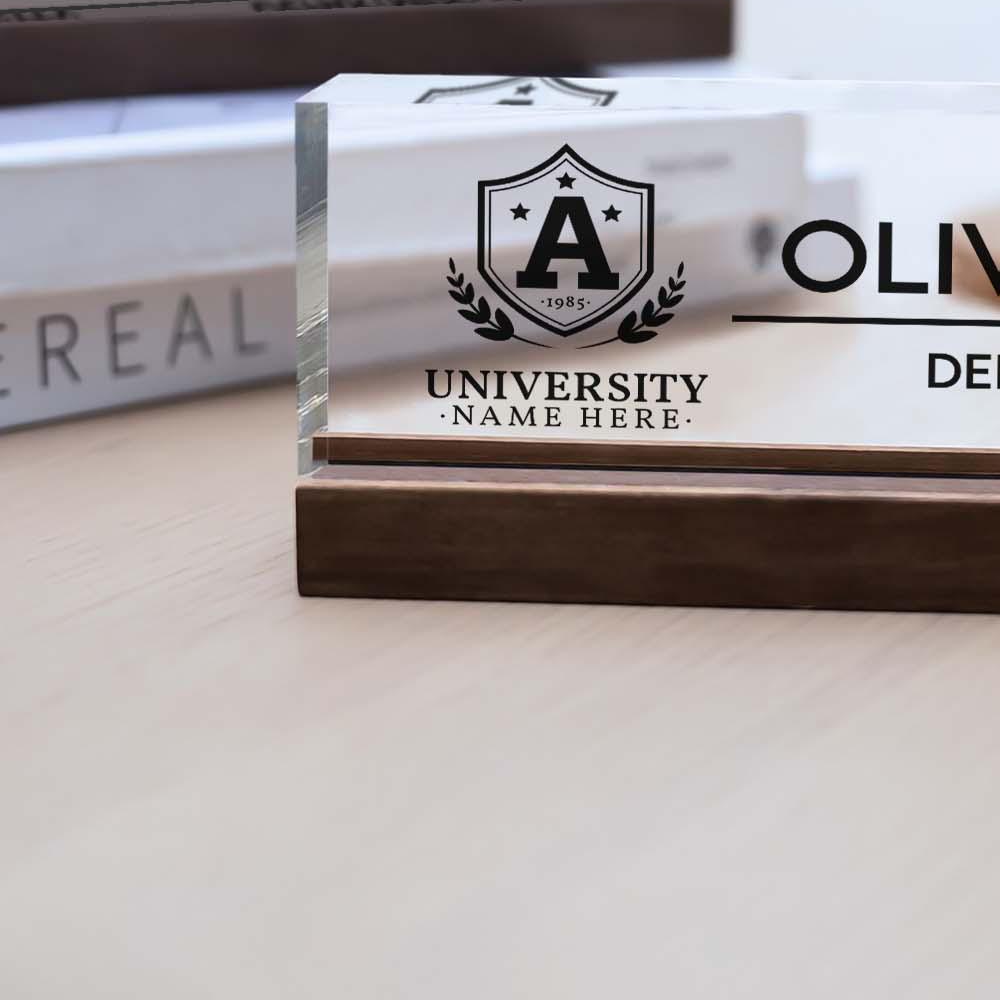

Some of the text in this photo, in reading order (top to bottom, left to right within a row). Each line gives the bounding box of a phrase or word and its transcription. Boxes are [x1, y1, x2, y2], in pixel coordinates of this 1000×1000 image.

[516, 196, 619, 290] A
[0, 284, 267, 396] REAL
[425, 368, 708, 403] UNIVERSITY
